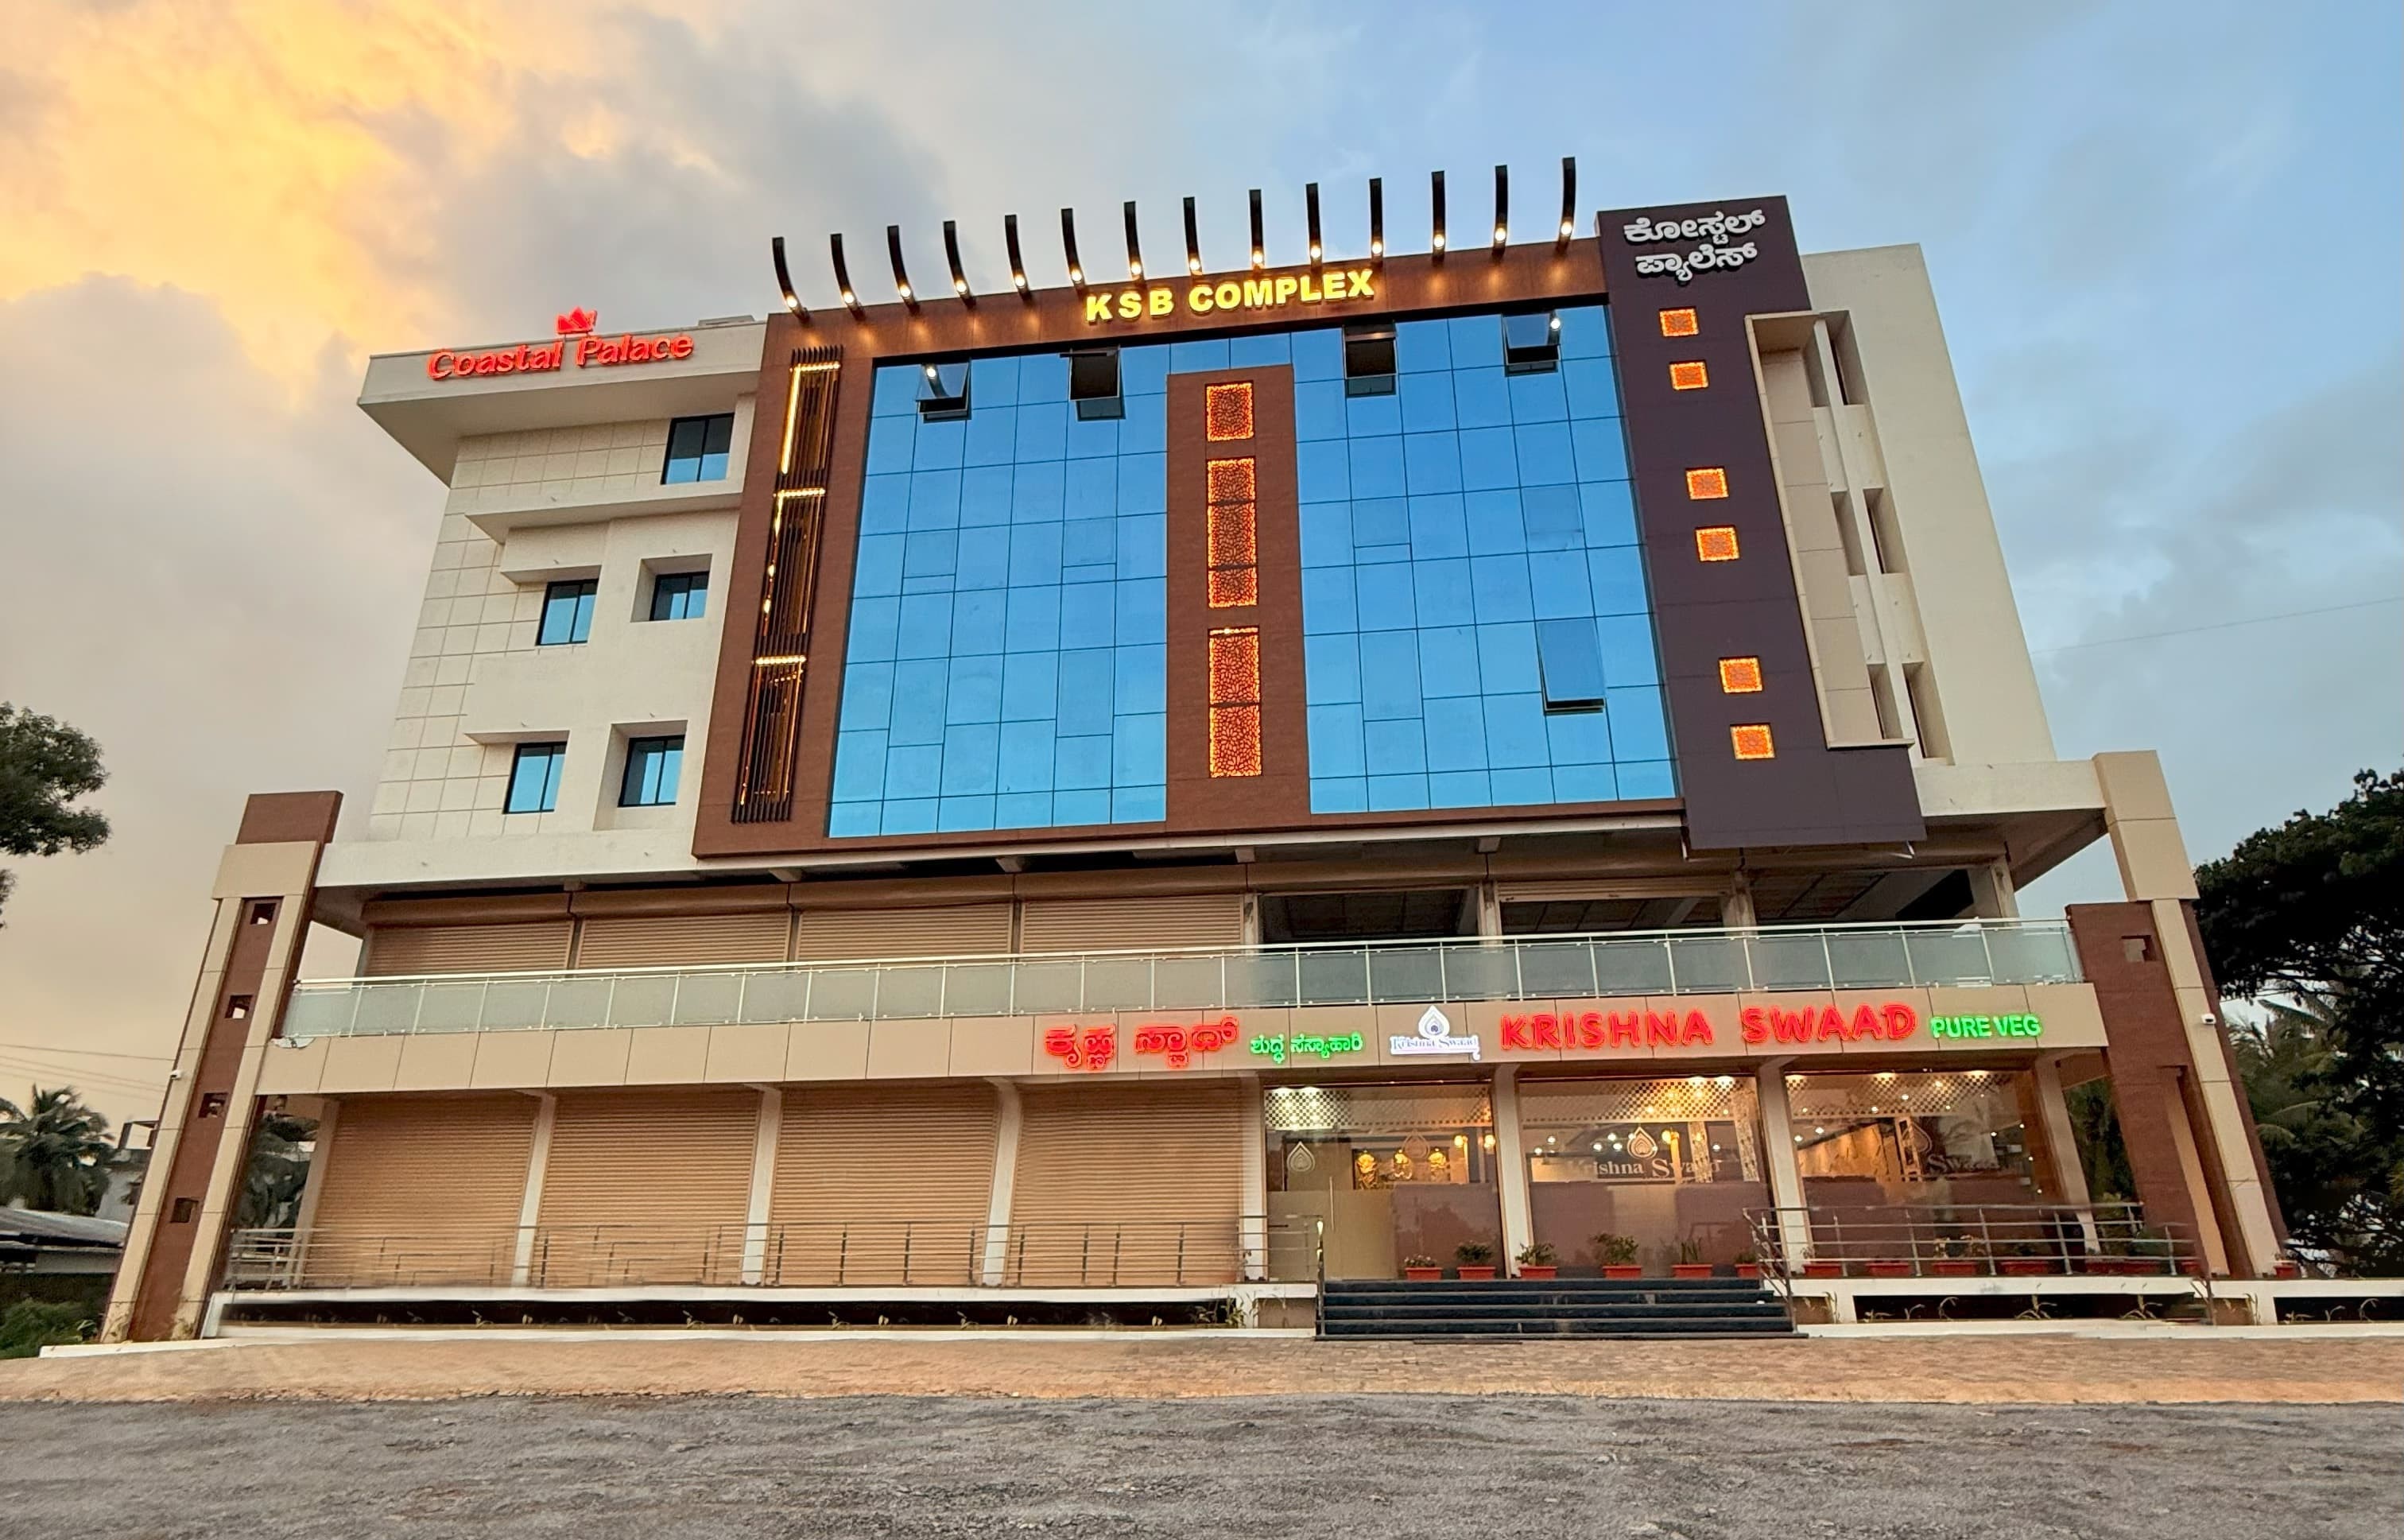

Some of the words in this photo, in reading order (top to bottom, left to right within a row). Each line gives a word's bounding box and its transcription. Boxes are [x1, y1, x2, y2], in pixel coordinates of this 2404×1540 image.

[1623, 209, 1766, 245] ಕೋಸ್ಟಲ್
[1085, 286, 1174, 323] KSB
[1188, 269, 1375, 314] COMPLEX
[427, 341, 564, 381] Coastal
[574, 333, 695, 369] Palace
[1500, 1009, 1714, 1049] KRISHNA
[1742, 1003, 1917, 1042] SWAAD
[1930, 1015, 1991, 1039] PURE
[1993, 1014, 2042, 1037] VEG
